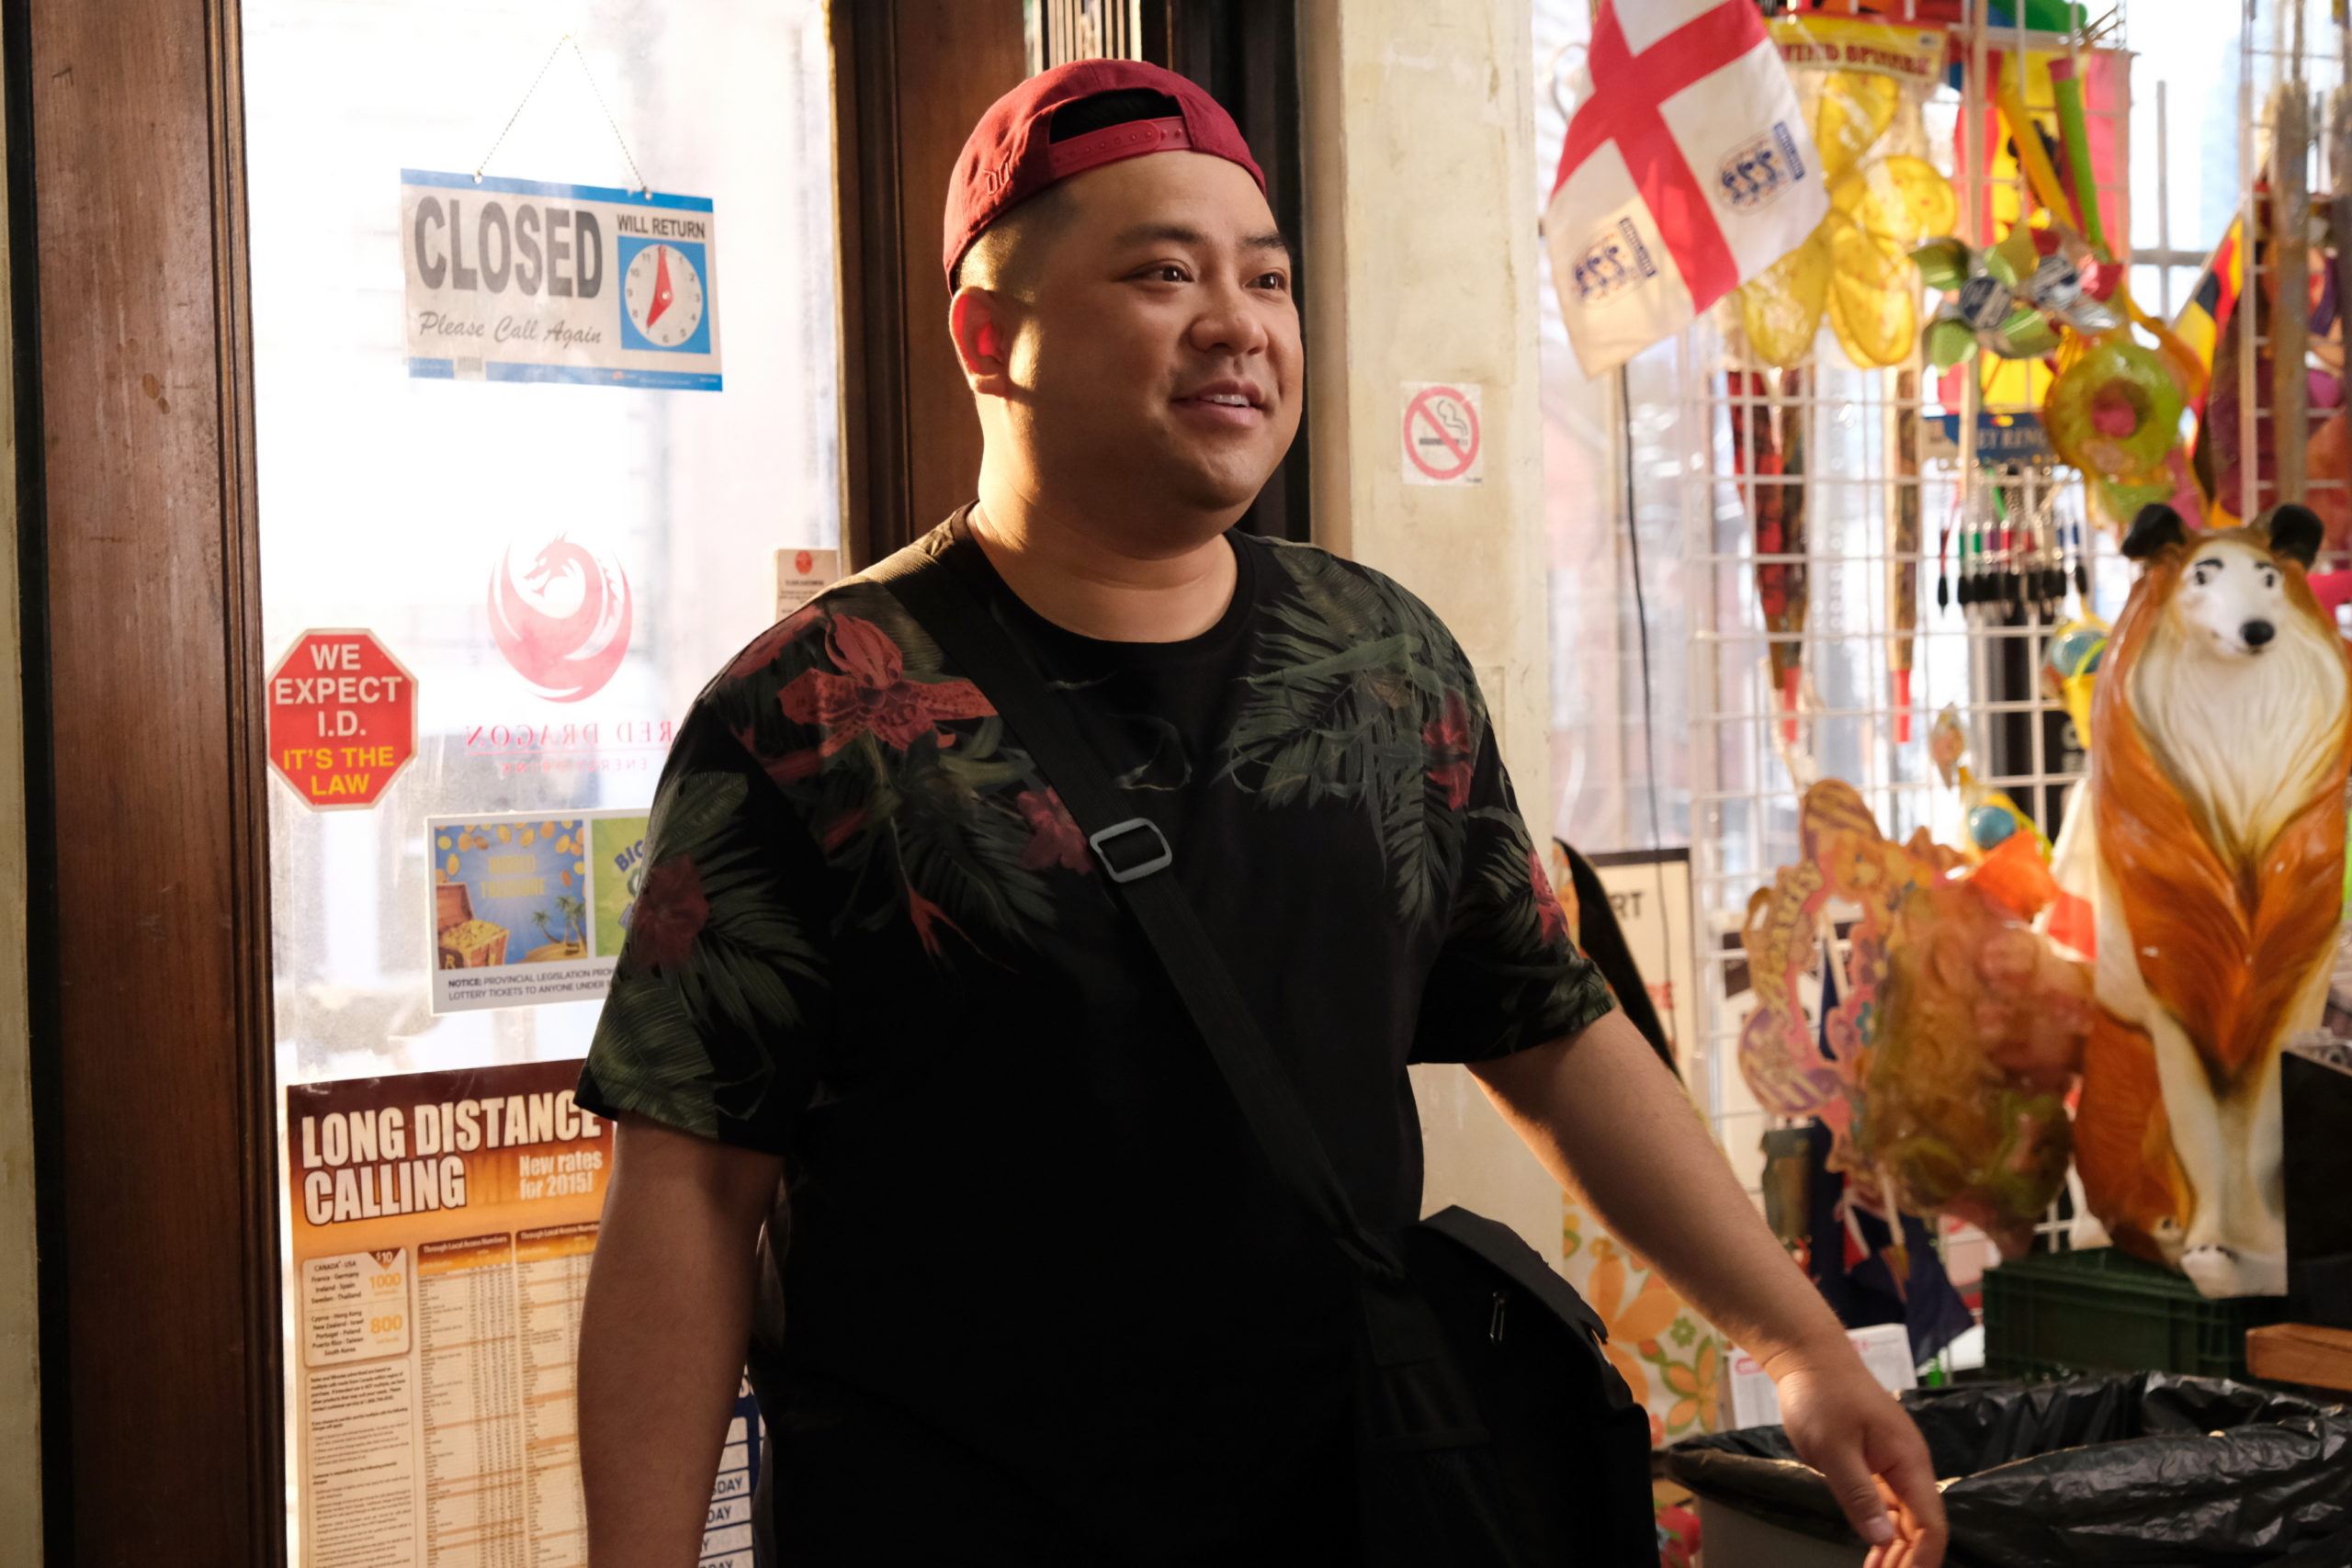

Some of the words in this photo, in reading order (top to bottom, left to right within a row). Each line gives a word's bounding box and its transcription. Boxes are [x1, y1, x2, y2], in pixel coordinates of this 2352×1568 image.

[616, 213, 649, 233] WILL
[652, 218, 706, 239] RETURN
[414, 196, 603, 299] CLOSED
[419, 310, 485, 337] Please
[493, 315, 539, 344] Call
[543, 320, 602, 349] Again
[310, 644, 361, 671] WE
[275, 676, 403, 705] EXPECT
[318, 710, 367, 738] I.D.
[283, 748, 334, 771] IT'S
[340, 746, 395, 768] THE
[311, 773, 370, 796] LAW
[1610, 892, 1643, 918] RT
[448, 978, 482, 988] NOTICE:
[484, 975, 535, 985] PROVINCIAL
[537, 970, 591, 981] LEGISLATION
[448, 989, 486, 1000] LOTTERY
[490, 987, 523, 997] TICKETS
[526, 986, 537, 994] TO
[538, 983, 574, 993] ANYONE
[576, 980, 605, 989] UNDER
[302, 1107, 406, 1168] LONG
[414, 1089, 602, 1156] DISTANCE
[518, 1155, 554, 1178] New
[558, 1150, 603, 1173] rates
[304, 1155, 467, 1225] CALLING
[519, 1178, 544, 1201] for
[546, 1171, 594, 1198] 2015!
[368, 1272, 401, 1290] 1000
[370, 1314, 403, 1334] 800
